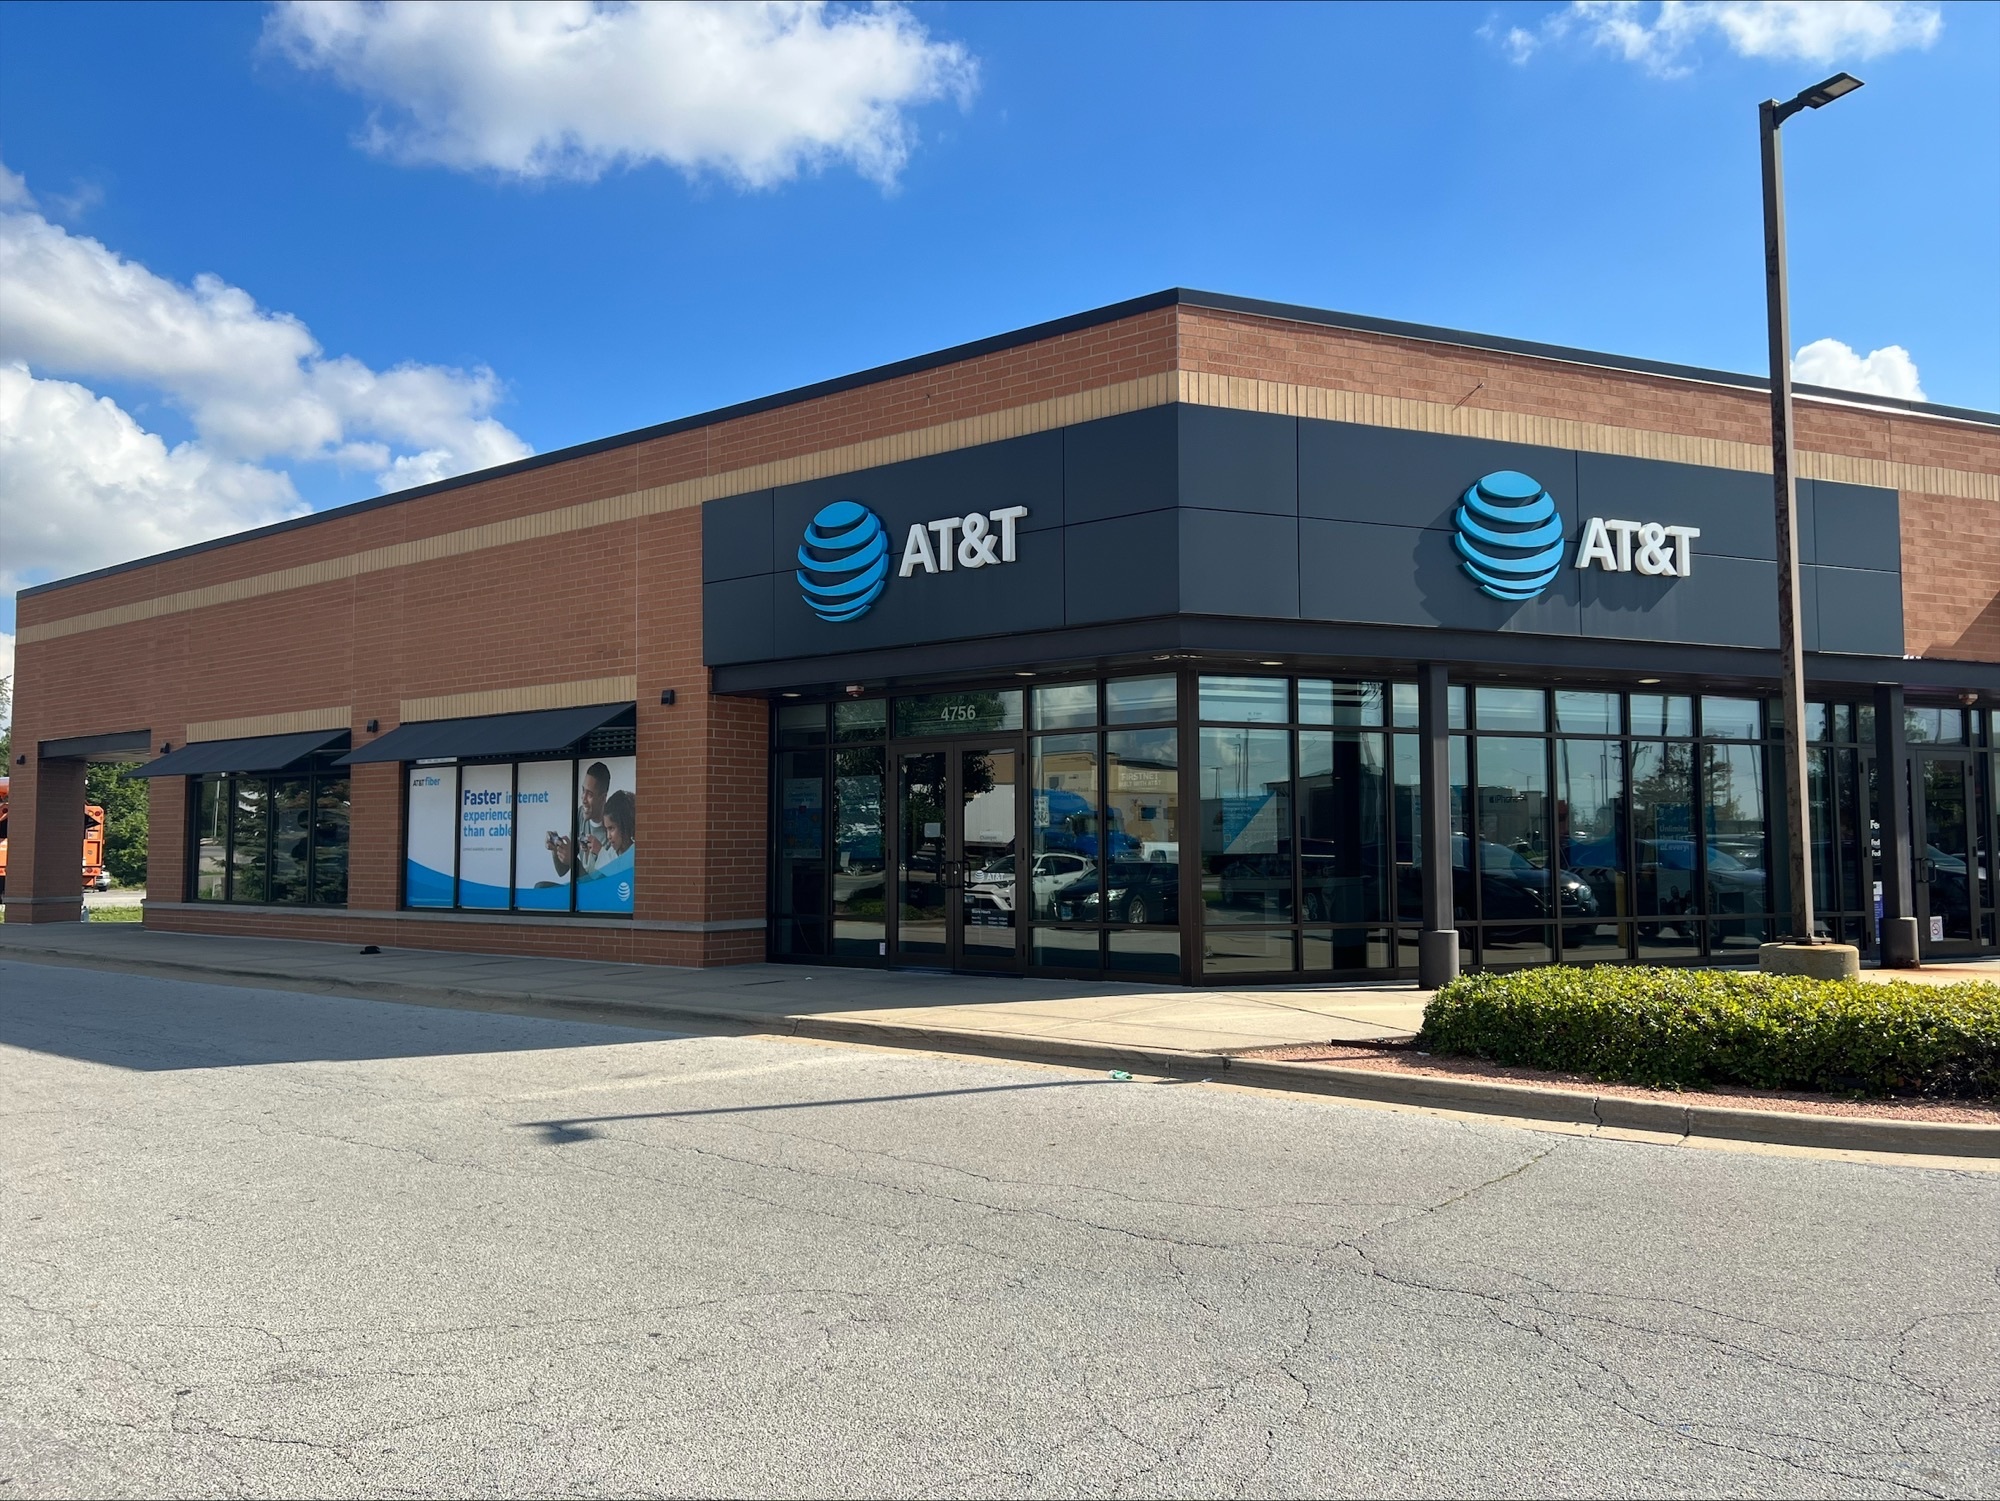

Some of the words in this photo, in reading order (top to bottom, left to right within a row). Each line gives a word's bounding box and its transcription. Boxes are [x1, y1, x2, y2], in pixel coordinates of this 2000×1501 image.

[899, 505, 1028, 578] AT&T
[1574, 517, 1701, 578] AT&T
[940, 704, 976, 722] 4756
[412, 779, 425, 787] AT&T
[425, 776, 441, 786] fiber
[463, 789, 502, 806] Faster
[463, 807, 512, 825] experience
[463, 825, 485, 837] than
[489, 824, 512, 837] cable
[1870, 819, 1880, 830] Fe
[1871, 838, 1881, 846] Fed
[1871, 849, 1881, 857] Fed
[987, 872, 1005, 881] AT&T
